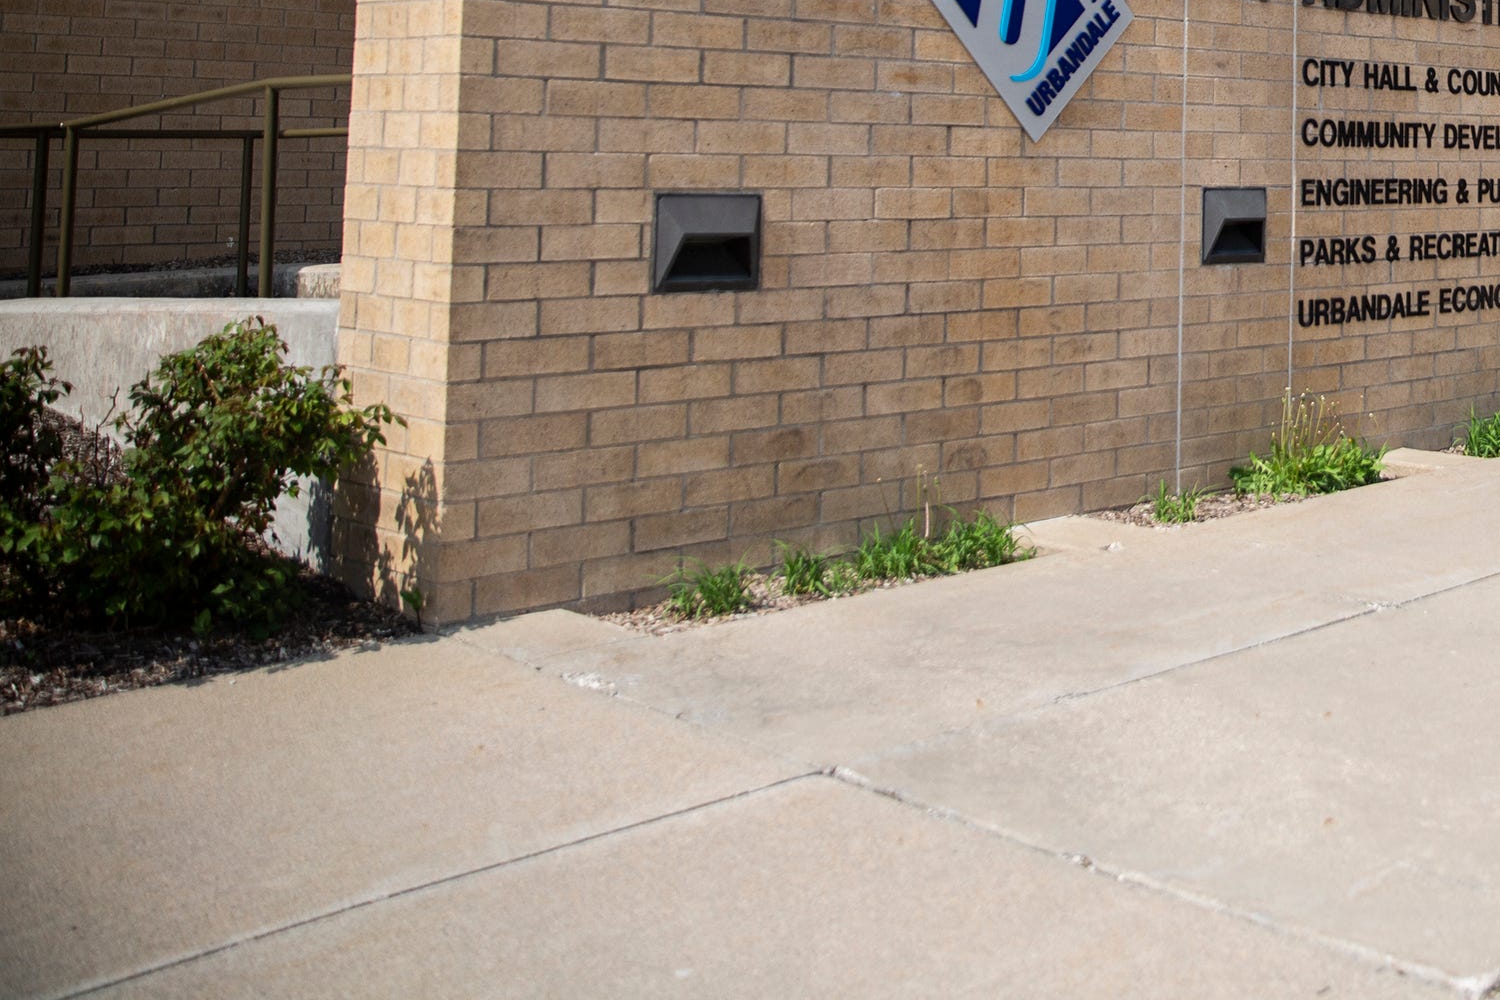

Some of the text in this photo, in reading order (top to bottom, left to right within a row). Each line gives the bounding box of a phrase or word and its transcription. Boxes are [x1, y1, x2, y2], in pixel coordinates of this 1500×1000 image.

[1302, 58, 1354, 88] CITY
[1364, 63, 1417, 91] HALL
[1425, 67, 1439, 94] &
[1301, 118, 1436, 148] COMMUNITY
[1301, 178, 1448, 206] ENGINEERING
[1456, 178, 1469, 204] &
[1300, 235, 1376, 267] PARKS
[1385, 235, 1400, 262] &
[1298, 290, 1430, 327] URBANDALE
